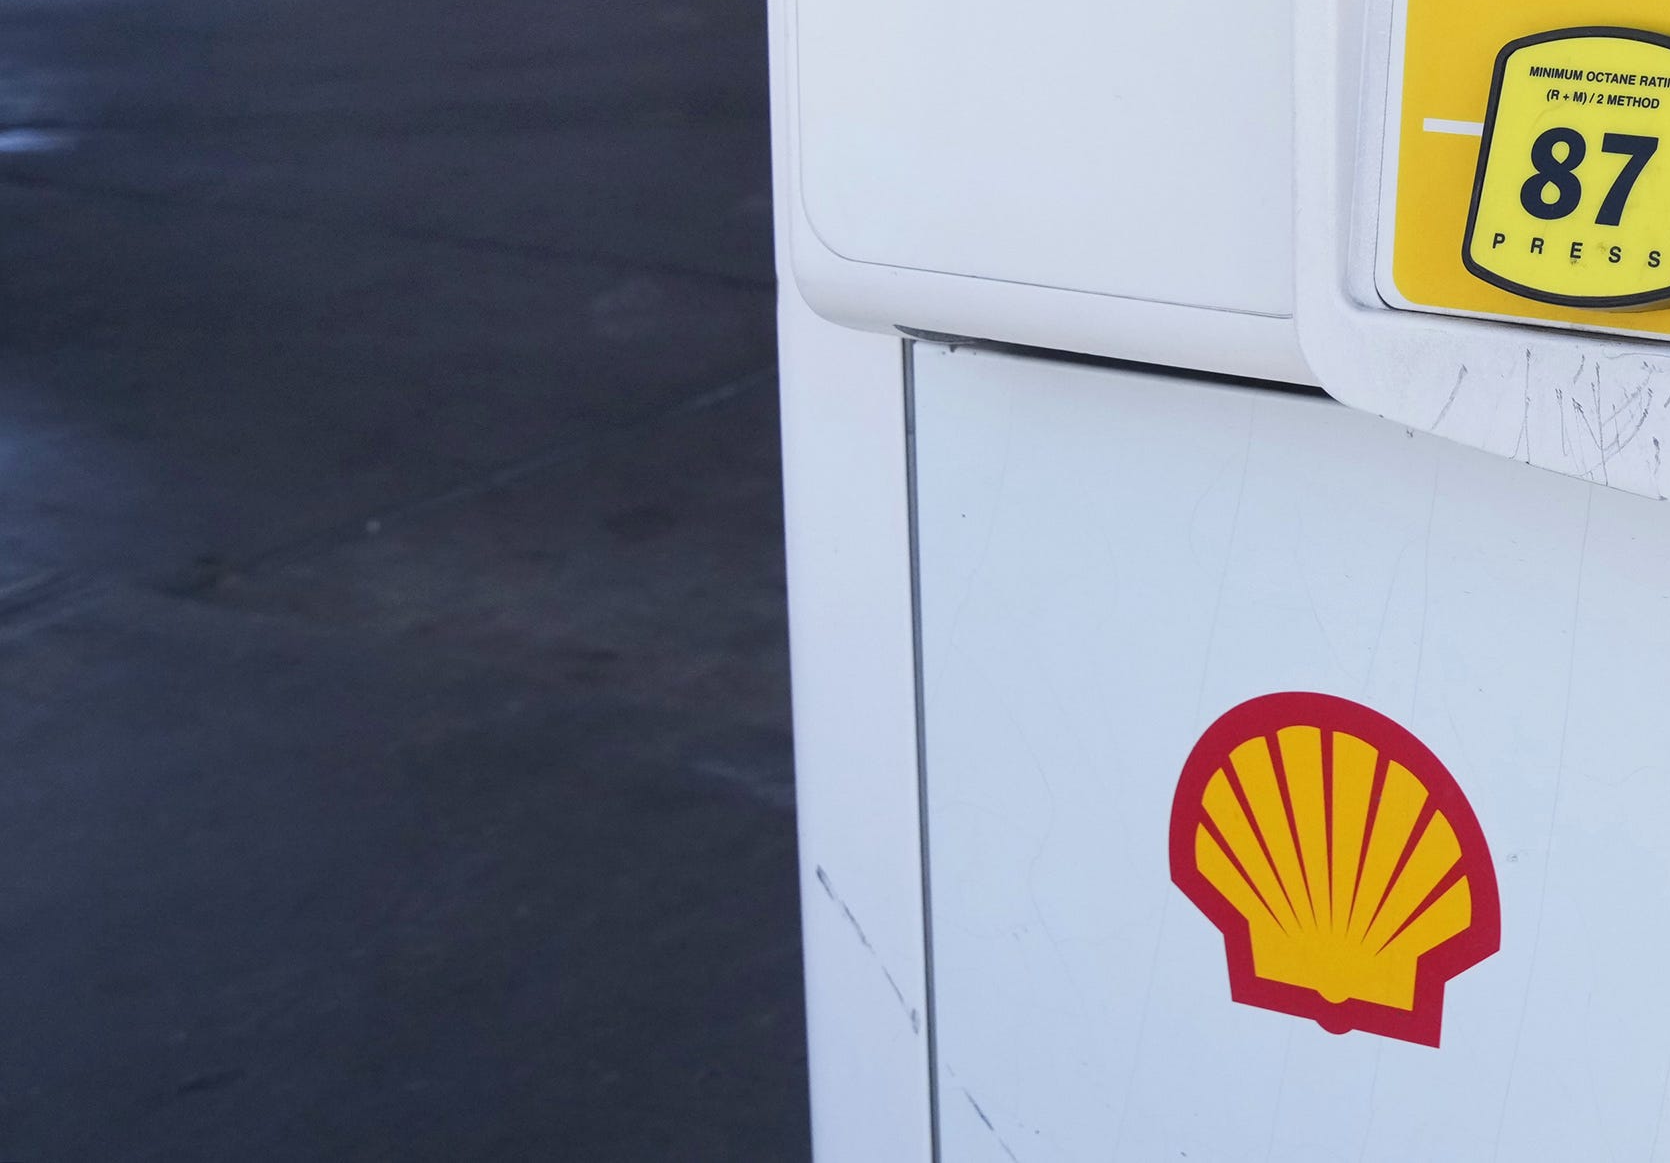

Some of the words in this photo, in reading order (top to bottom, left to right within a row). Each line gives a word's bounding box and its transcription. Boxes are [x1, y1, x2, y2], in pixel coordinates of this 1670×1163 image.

[1529, 66, 1584, 82] MINIMUM
[1586, 70, 1637, 86] OCTANE
[1546, 89, 1560, 102] (R
[1572, 92, 1587, 105] M)
[1589, 92, 1595, 105] /
[1597, 93, 1604, 105] 2
[1606, 94, 1661, 110] METHOD
[1520, 127, 1659, 227] 87
